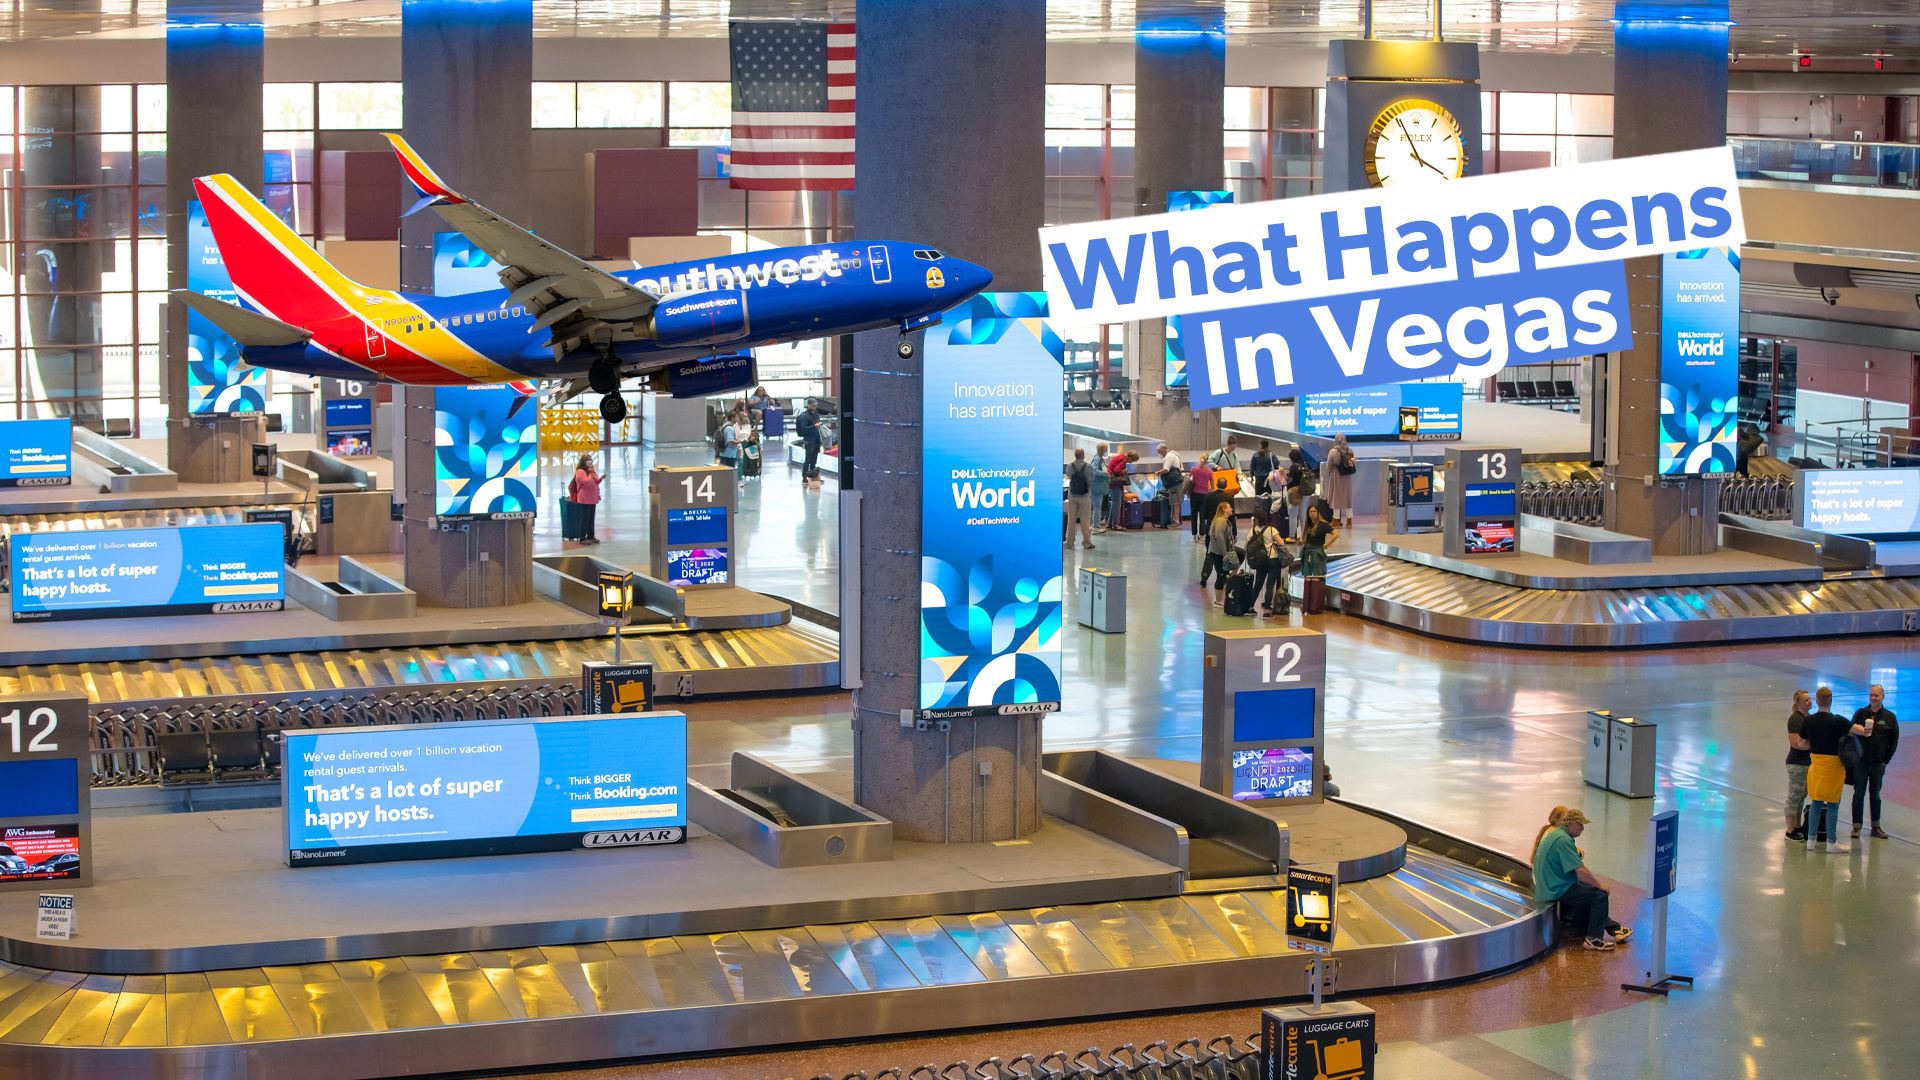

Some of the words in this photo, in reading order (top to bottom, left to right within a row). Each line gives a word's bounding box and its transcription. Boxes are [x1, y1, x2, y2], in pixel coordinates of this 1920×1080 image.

[1400, 134, 1432, 142] ROLEX
[618, 249, 843, 297] outhwest
[1680, 281, 1724, 290] Innovation
[1676, 293, 1692, 303] has
[1694, 292, 1726, 303] arrived.
[385, 314, 423, 326] N906WN
[1678, 339, 1724, 356] World
[336, 378, 363, 397] 16
[954, 382, 1034, 398] Innovation
[950, 403, 977, 418] has
[981, 401, 1038, 418] arrived.
[1305, 406, 1330, 416] That's
[1339, 406, 1351, 415] lot
[1352, 405, 1362, 415] of
[1363, 407, 1388, 416] super
[1306, 418, 1332, 428] happy
[1334, 417, 1358, 426] hosts.
[22, 454, 67, 463] Booking.com
[1476, 452, 1507, 480] 13
[680, 474, 716, 504] 14
[952, 480, 1035, 509] World
[1811, 499, 1840, 510] That's
[1850, 498, 1862, 508] lot
[1864, 497, 1875, 508] of
[1877, 499, 1904, 510] super
[966, 516, 1020, 526] #DellTechWorld
[1811, 512, 1841, 525] happy
[1843, 511, 1872, 522] hosts.
[46, 544, 79, 552] delivered
[22, 554, 42, 563] rental
[44, 554, 64, 564] guest
[65, 553, 92, 561] arrivals.
[681, 560, 700, 570] NFL
[22, 567, 63, 580] That's
[67, 570, 75, 578] a
[79, 565, 98, 578] lot
[101, 564, 116, 577] of
[118, 565, 158, 578] super
[220, 571, 278, 581] Booking.com
[681, 568, 714, 578] DRAFT
[23, 584, 67, 599] happy
[71, 582, 111, 594] hosts.
[219, 602, 274, 612] LAMAR
[1254, 642, 1302, 684] 12
[1004, 704, 1052, 713] LAMAR
[1, 707, 59, 753] 12
[304, 752, 335, 763] We've
[339, 749, 387, 761] delivered
[390, 749, 413, 758] over
[425, 745, 457, 756] billion
[459, 743, 502, 754] vacation
[304, 766, 334, 777] rental
[336, 765, 365, 778] guest
[368, 762, 408, 773] arrivals.
[569, 776, 592, 785] Think
[594, 774, 631, 784] BIGGER
[1251, 776, 1294, 790] DRAFT
[304, 783, 364, 803] That's
[370, 787, 381, 800] a
[387, 779, 415, 798] lot
[420, 777, 442, 797] of
[446, 778, 503, 798] super
[570, 792, 592, 800] Think
[594, 785, 678, 800] Booking.com
[305, 808, 369, 830] happy
[375, 804, 434, 823] hosts.
[5, 828, 25, 836] AWG
[592, 830, 671, 845] LAMAR
[301, 850, 346, 859] NanoLumens
[1290, 871, 1332, 884] smartecarte
[40, 897, 71, 908] NOTICE
[1304, 1022, 1343, 1033] LUGGAGE
[1345, 1020, 1370, 1029] CARTS
